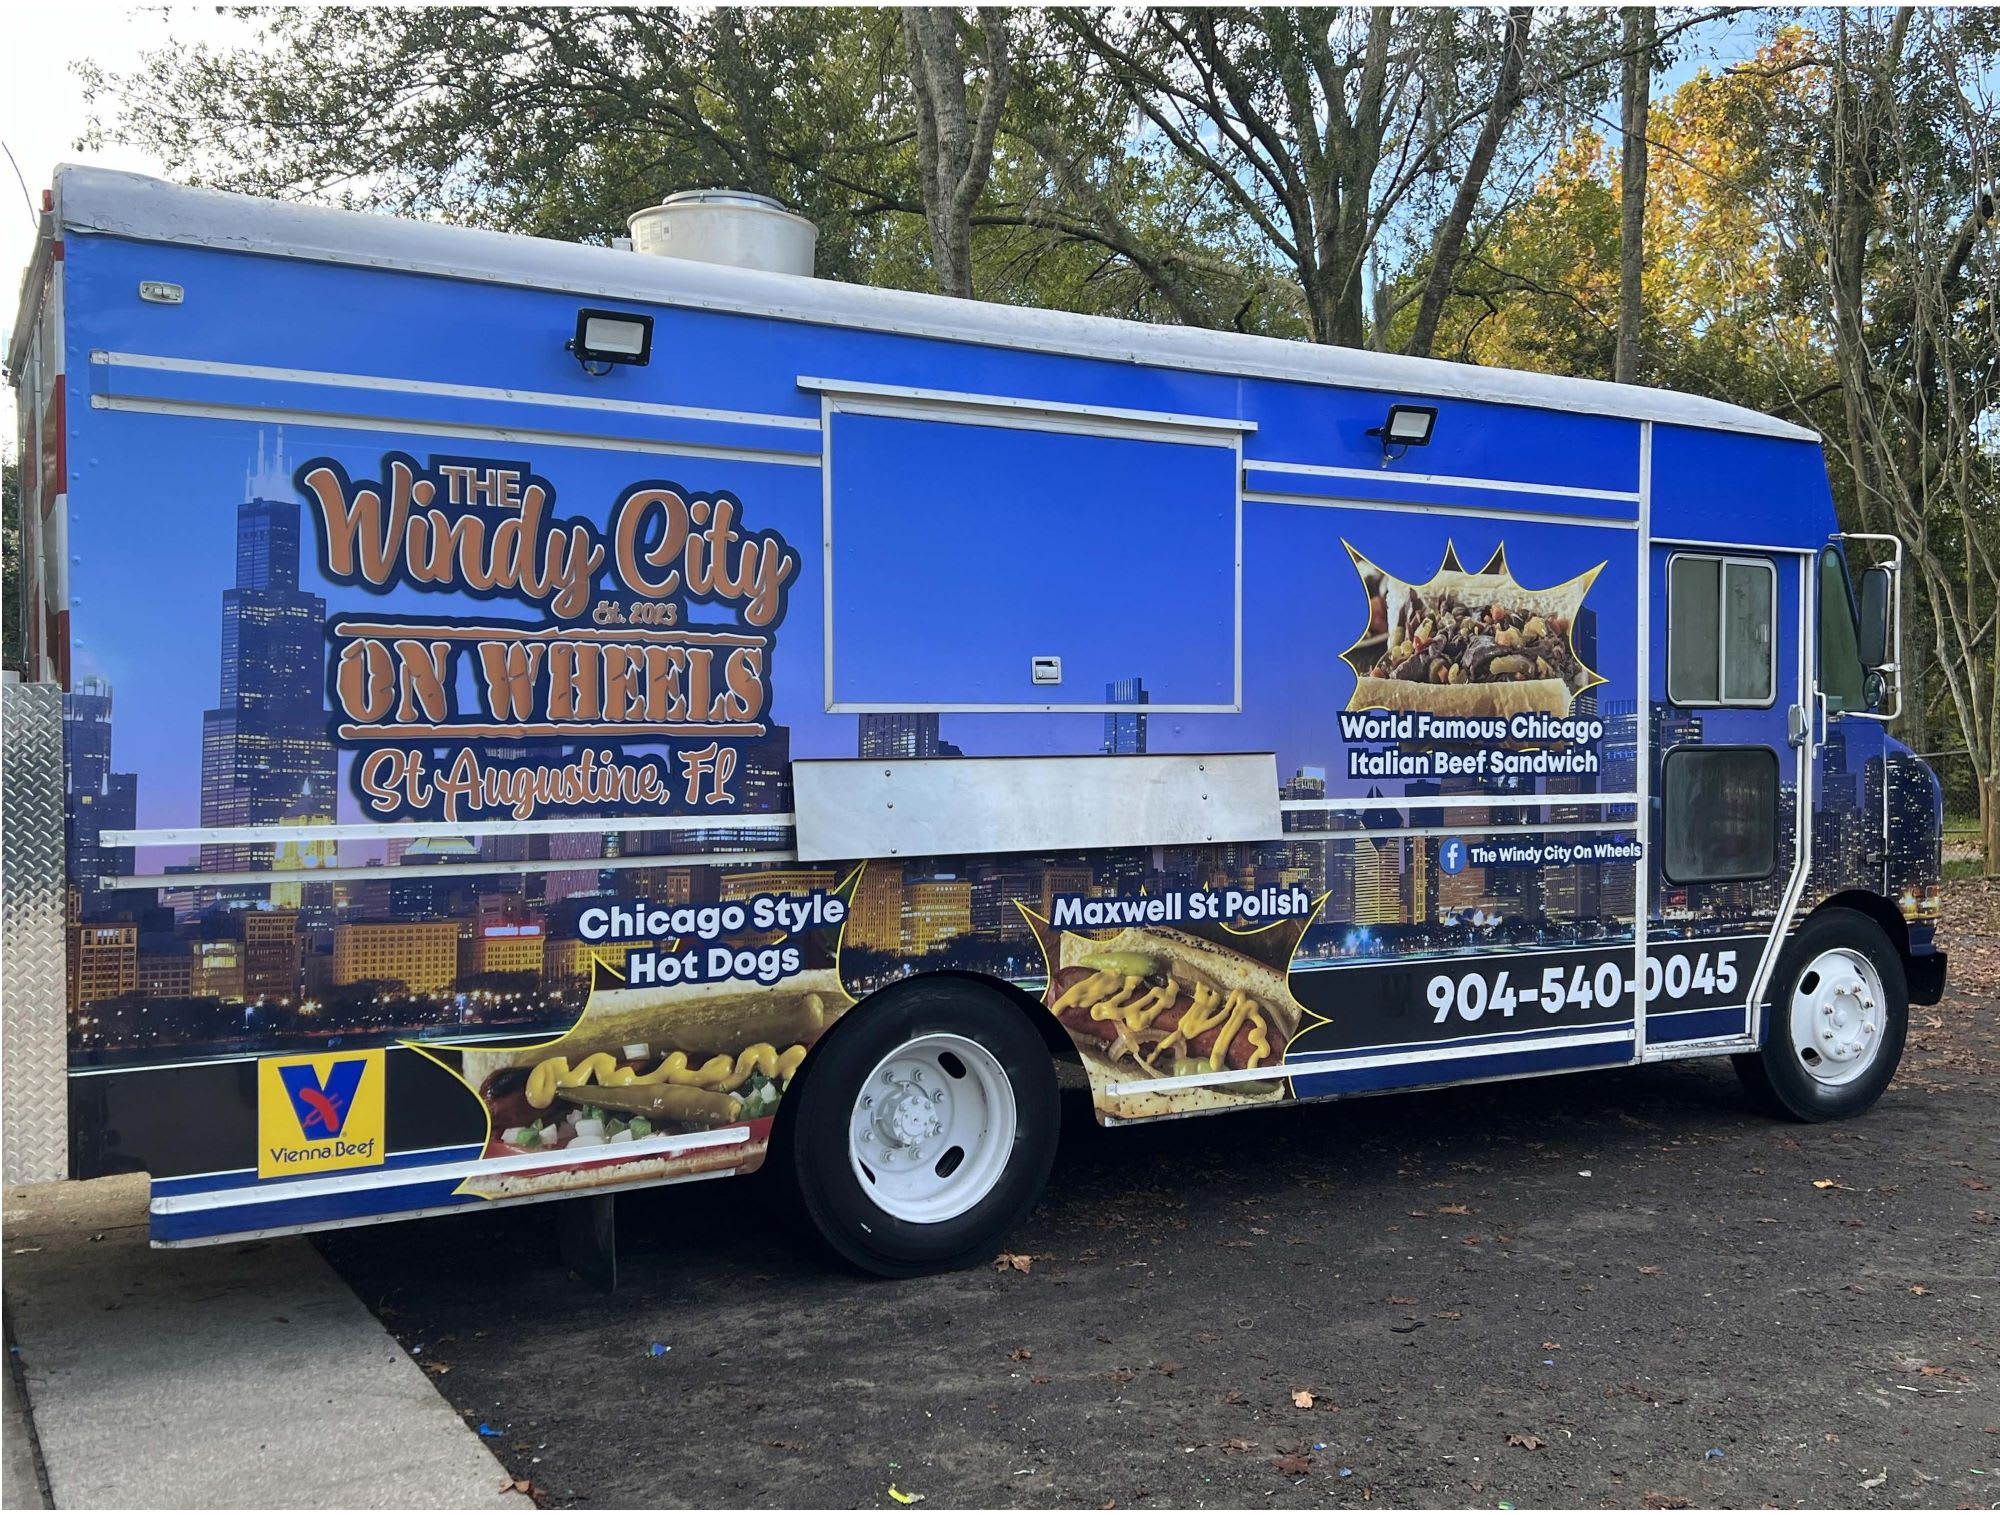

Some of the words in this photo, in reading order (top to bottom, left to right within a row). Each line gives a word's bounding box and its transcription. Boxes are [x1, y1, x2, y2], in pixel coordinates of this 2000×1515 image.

[439, 464, 521, 508] THE
[304, 460, 604, 619] Windy
[615, 489, 792, 626] City
[592, 600, 626, 625] Est.
[629, 602, 677, 626] 2023
[336, 638, 450, 722] ON
[478, 641, 763, 722] WHEELS
[1341, 715, 1412, 739] World
[1418, 716, 1507, 739] Famous
[1511, 716, 1602, 744] Chicago
[1351, 750, 1428, 775] Italian
[1435, 750, 1487, 774] Beef
[1490, 749, 1598, 773] Sandwich
[360, 748, 433, 811] St
[434, 748, 669, 822] Augustine,
[1471, 848, 1496, 863] The
[1499, 847, 1542, 868] Windy
[1544, 845, 1571, 862] City
[1573, 845, 1592, 859] On
[1594, 843, 1641, 858] Wheels
[579, 903, 745, 939] Chicago
[753, 894, 844, 932] Style
[1053, 893, 1181, 926] Maxwell
[1189, 892, 1219, 918] St
[1226, 888, 1308, 917] Polish
[630, 949, 698, 983] Hot
[707, 947, 799, 980] Dogs
[1426, 950, 1738, 1023] 904-540-0045
[270, 1147, 331, 1163] Vienna
[335, 1138, 374, 1158] Beef
